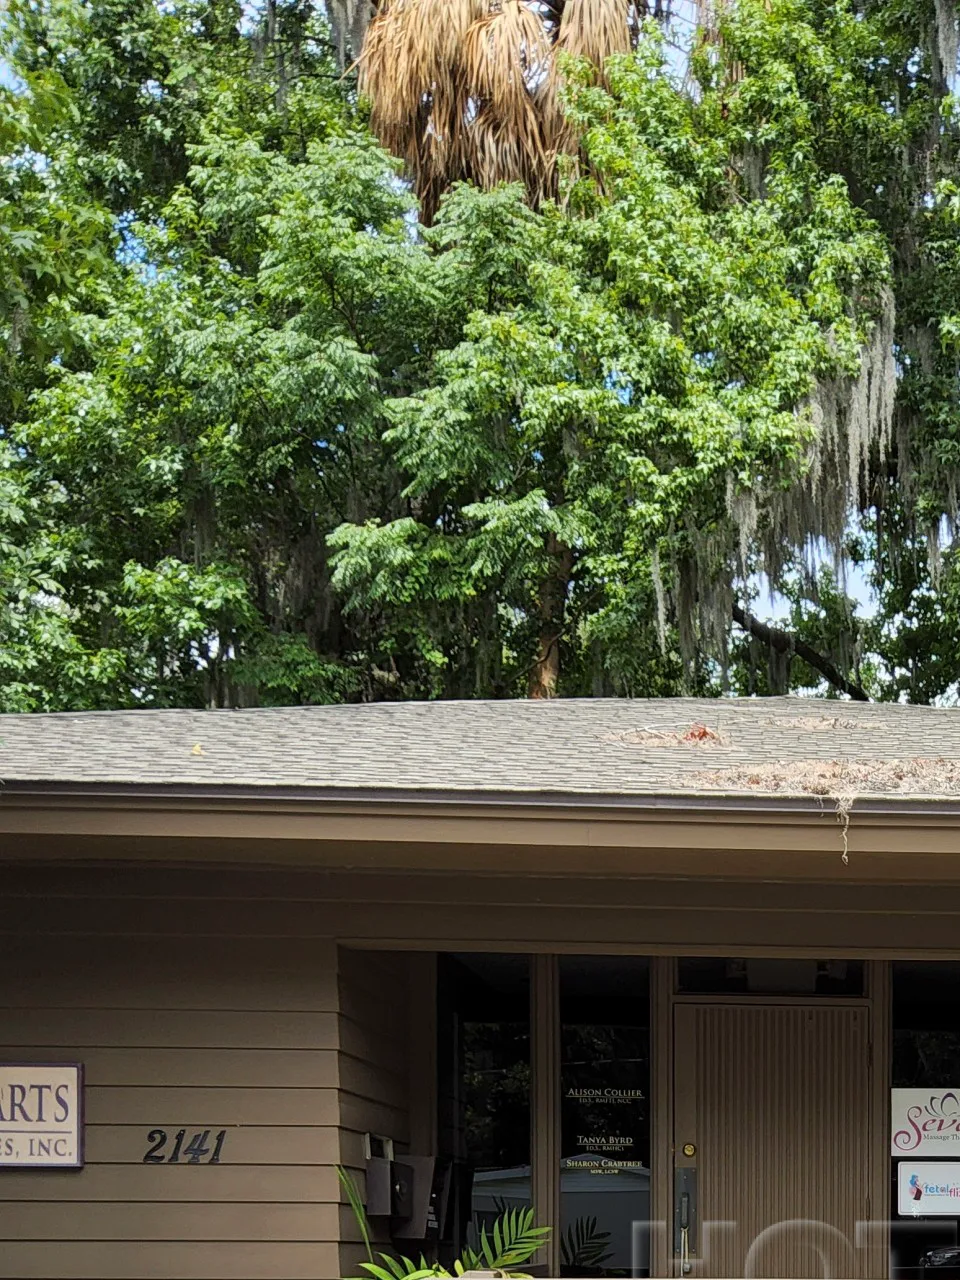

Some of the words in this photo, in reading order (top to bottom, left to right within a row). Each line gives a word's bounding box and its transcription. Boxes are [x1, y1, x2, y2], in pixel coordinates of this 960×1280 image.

[568, 1087, 602, 1096] ALISON
[604, 1088, 642, 1097] COLLIER
[0, 1084, 69, 1122] RTS
[143, 1129, 226, 1163] 2141
[577, 1135, 606, 1144] TANYA
[609, 1136, 633, 1144] BYRD
[0, 1138, 19, 1159] S,
[28, 1139, 72, 1156] INC.
[566, 1159, 599, 1167] SHARON
[601, 1159, 642, 1168] CRABTREE
